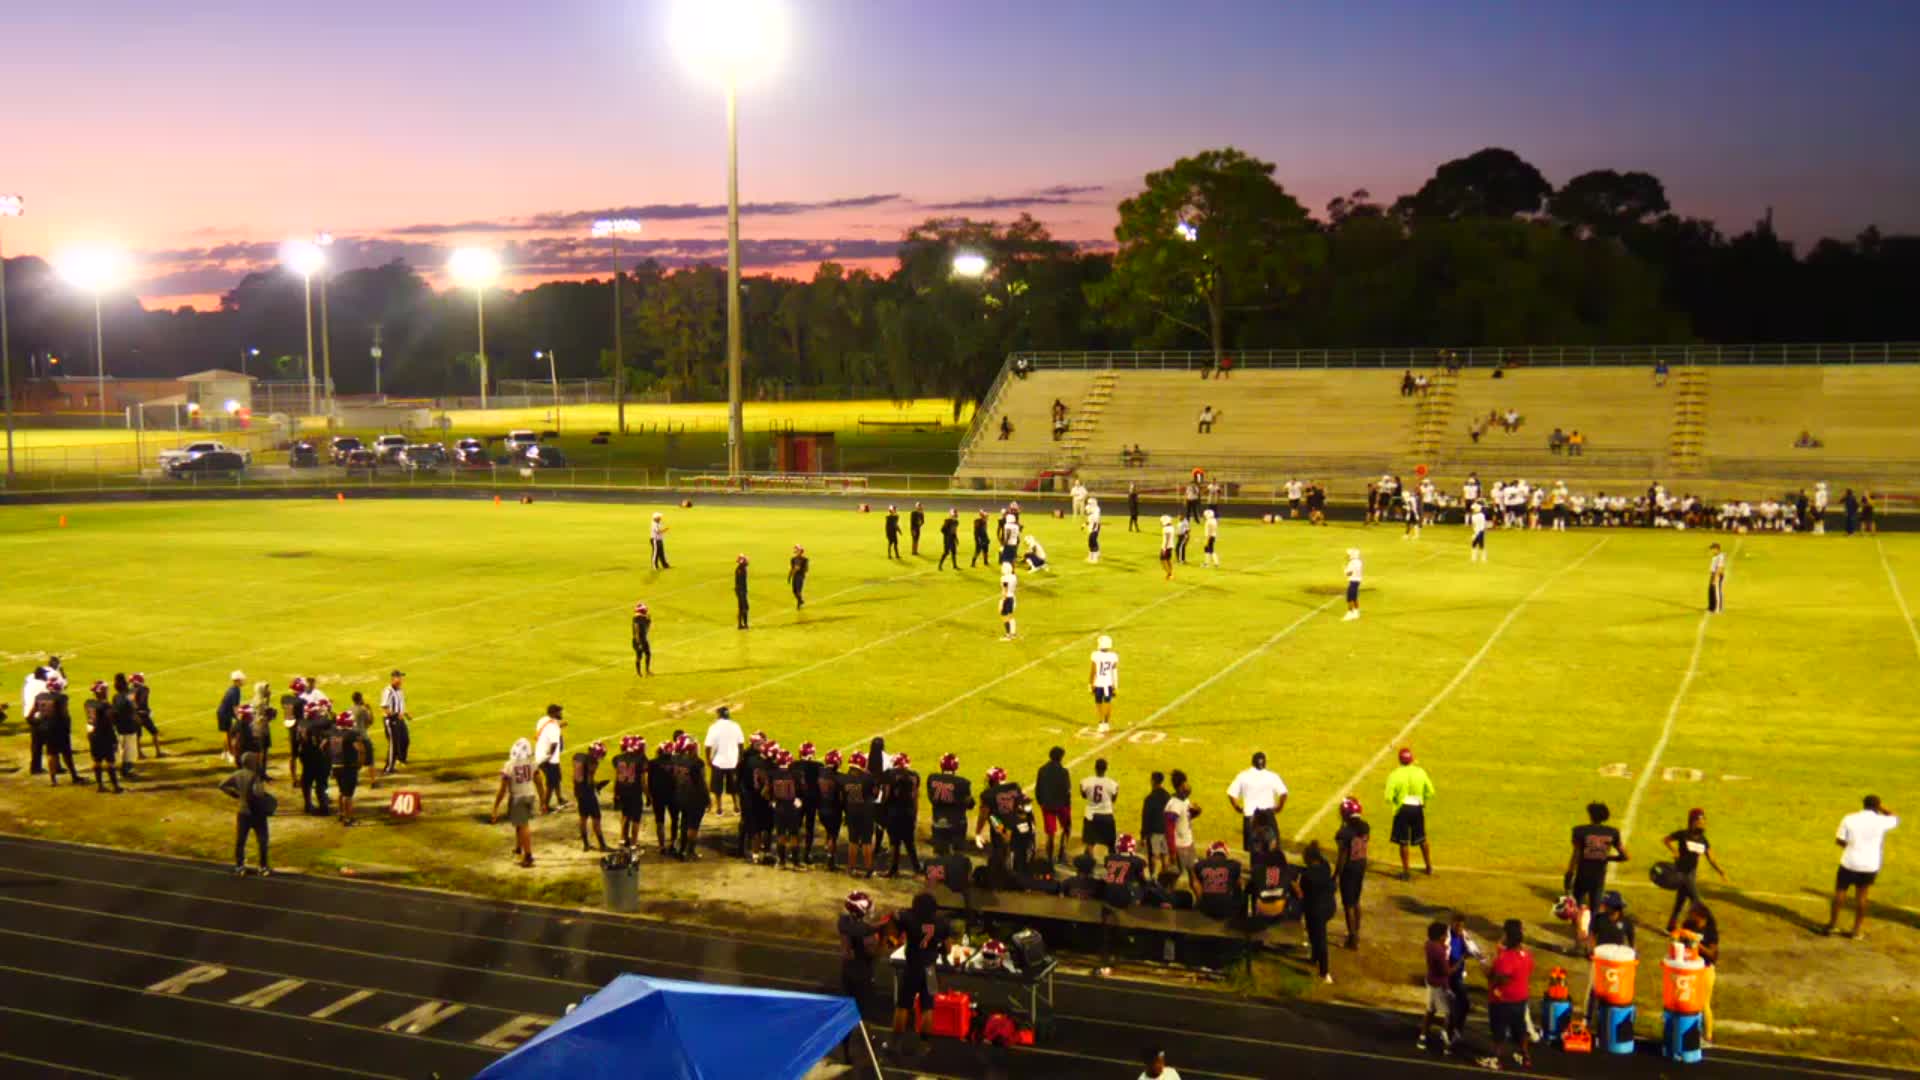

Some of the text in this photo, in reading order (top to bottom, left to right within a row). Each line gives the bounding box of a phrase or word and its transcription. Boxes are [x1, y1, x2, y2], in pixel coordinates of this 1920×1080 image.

[513, 764, 532, 785] 50
[391, 793, 415, 815] 40
[1093, 784, 1104, 804] 6
[921, 922, 936, 949] 7
